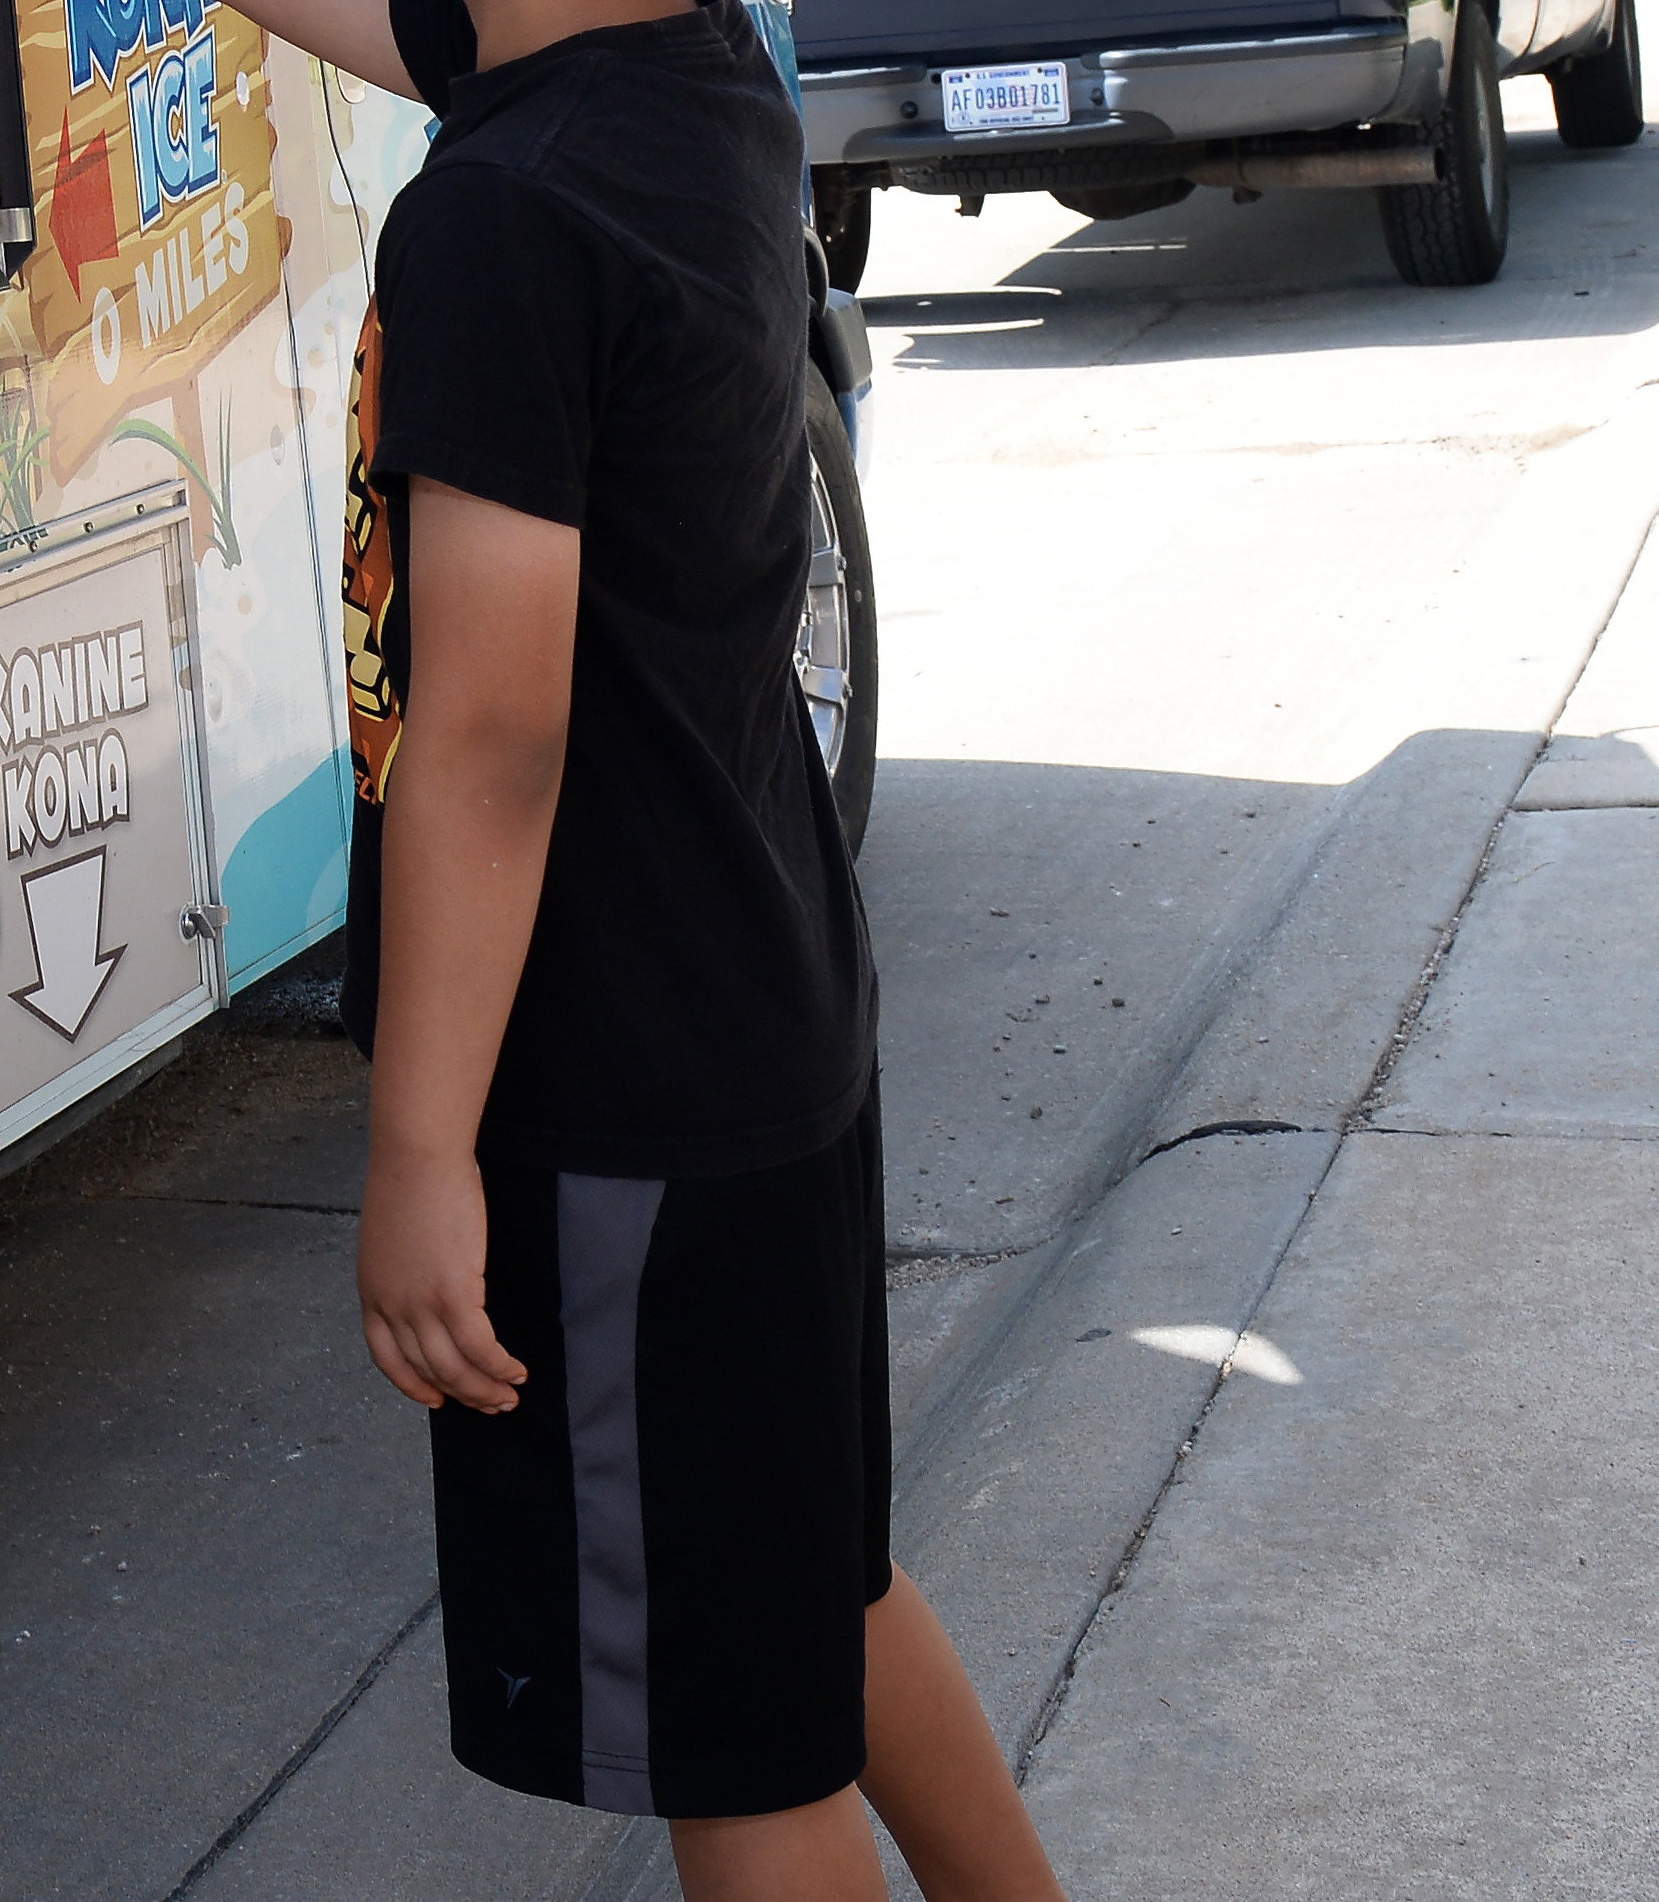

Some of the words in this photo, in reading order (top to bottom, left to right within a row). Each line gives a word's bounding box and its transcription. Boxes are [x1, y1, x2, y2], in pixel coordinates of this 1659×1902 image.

[127, 29, 222, 231] ICE
[135, 182, 249, 350] MILES
[2, 729, 130, 859] KONA
